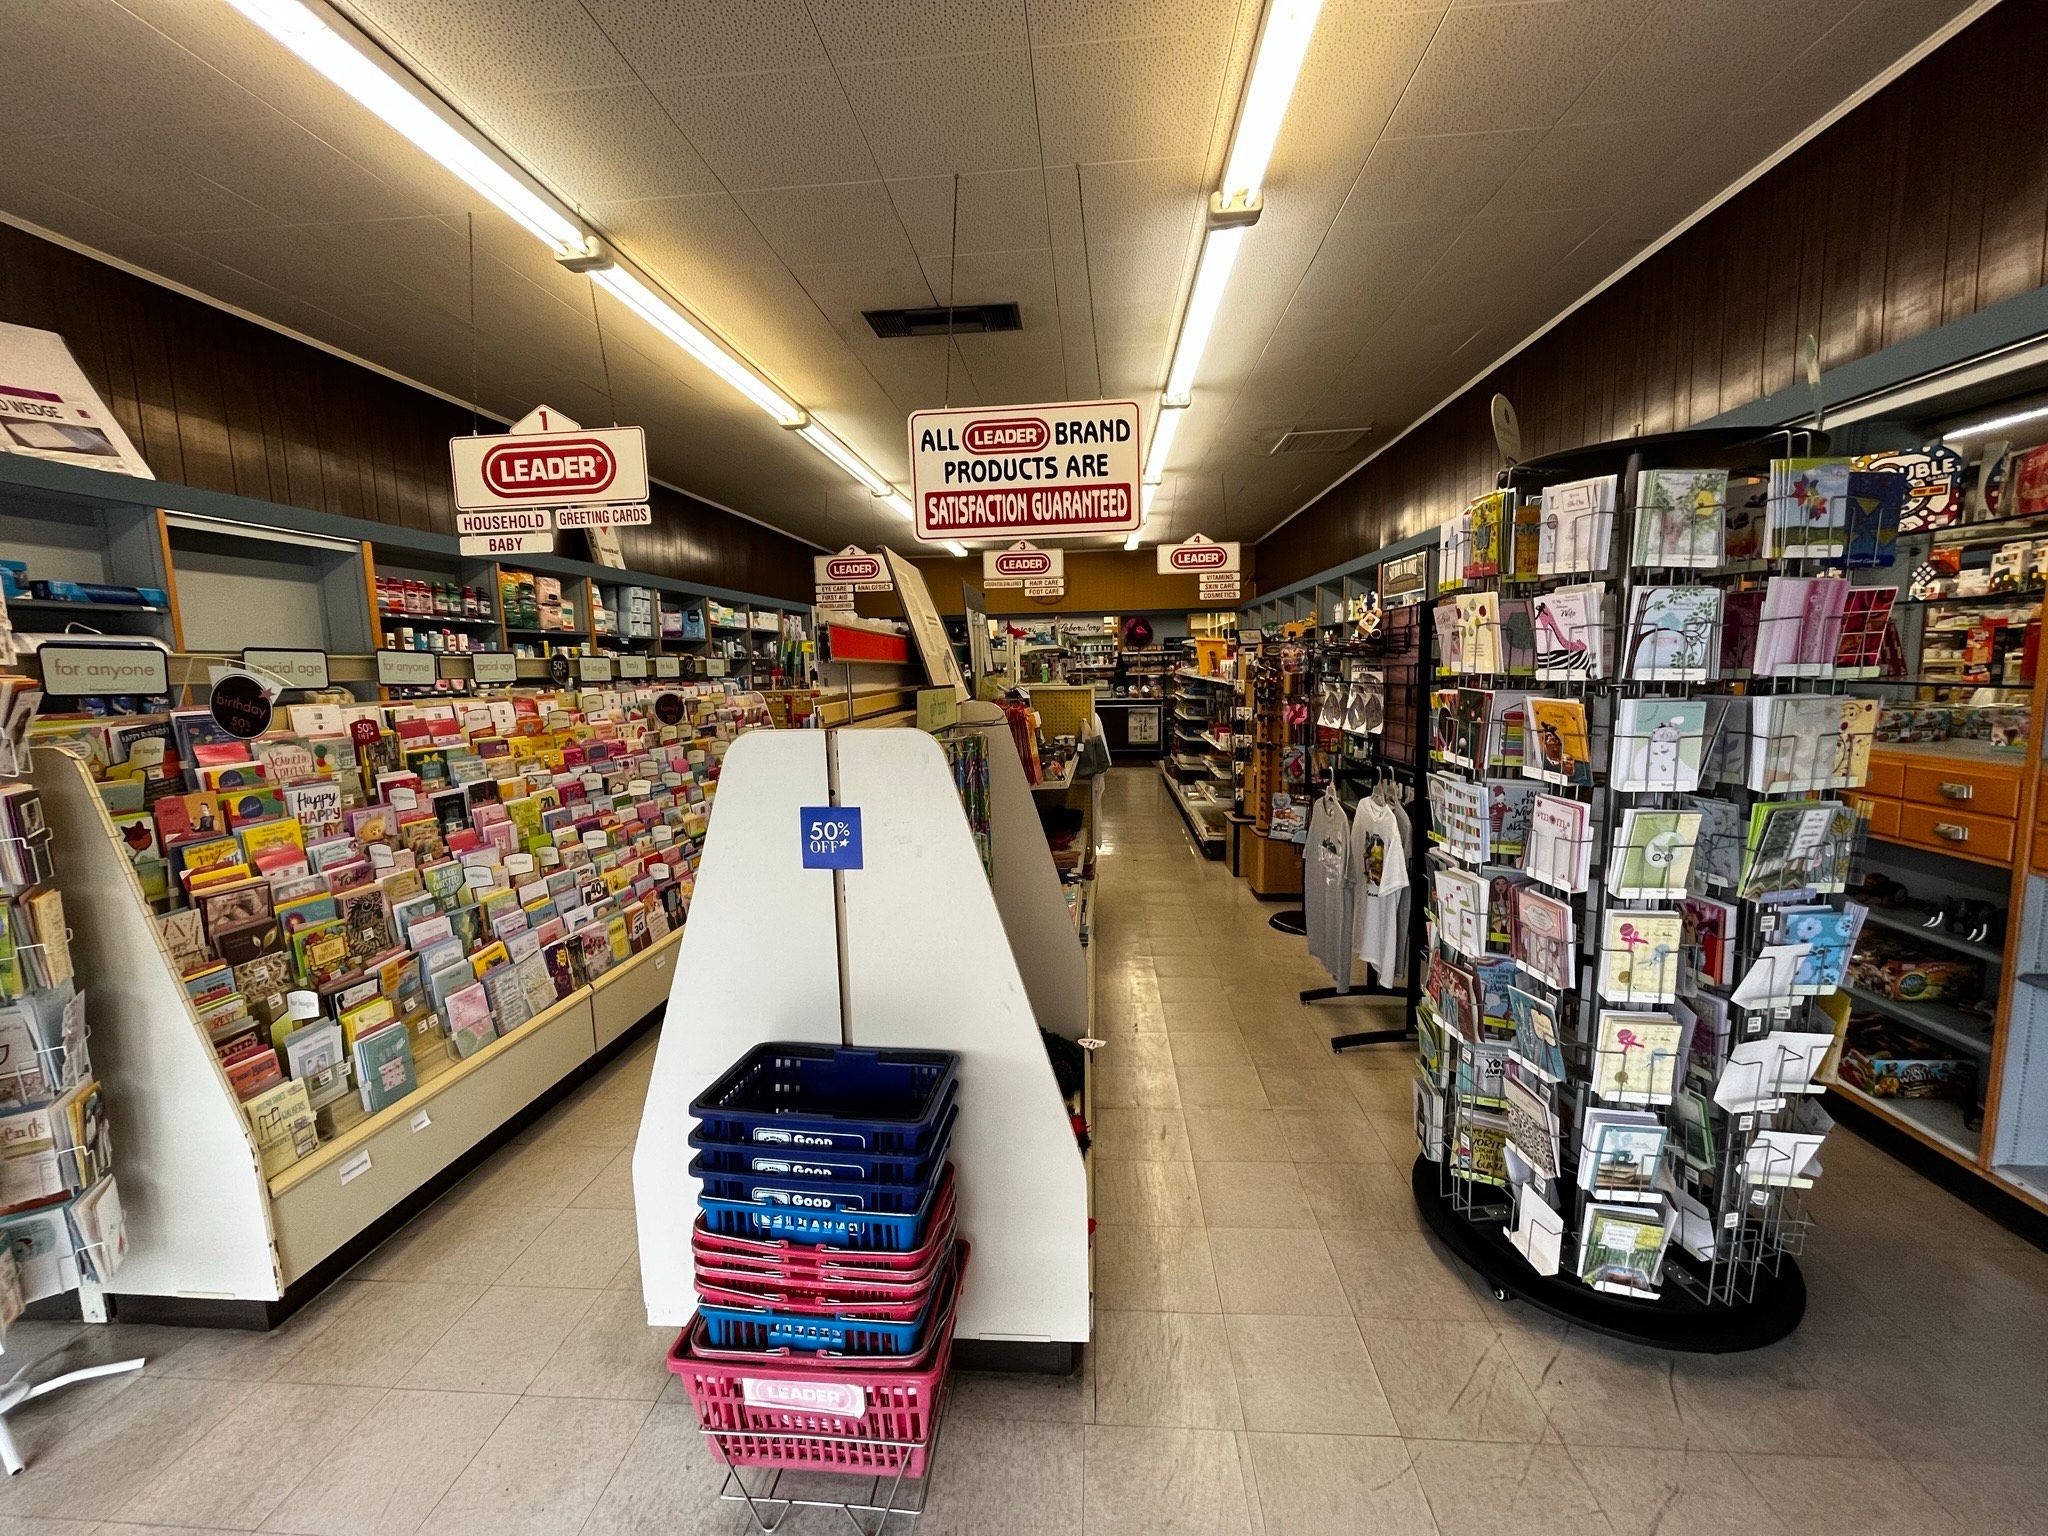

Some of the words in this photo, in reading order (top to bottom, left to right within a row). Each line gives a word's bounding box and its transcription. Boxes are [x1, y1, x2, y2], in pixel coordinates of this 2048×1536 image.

[11, 400, 65, 419] WEDGE
[538, 410, 549, 431] 1
[921, 427, 960, 452] ALL
[974, 428, 1037, 446] LEADER
[1055, 419, 1131, 445] BRAND
[500, 455, 597, 483] LEADER
[944, 456, 1058, 484] PRODUCTS
[1066, 453, 1109, 478] ARE
[928, 492, 1028, 525] SATISFACTION
[1031, 488, 1128, 521] GUARANTEED
[463, 514, 545, 531] HOUSEHOLD
[559, 510, 610, 526] GREETING
[612, 508, 648, 524] CARDS
[488, 537, 523, 552] BABY
[1020, 541, 1026, 550] 3
[1194, 535, 1200, 544] 4
[848, 546, 855, 555] 2
[1177, 552, 1219, 564] LEADER
[833, 564, 872, 575] LEADER
[1003, 559, 1043, 570] LEADER
[54, 658, 80, 676] for
[87, 665, 155, 681] anyone
[298, 664, 322, 677] age
[382, 658, 395, 672] for
[396, 663, 430, 674] anyone
[476, 660, 499, 674] special
[500, 663, 513, 674] age
[553, 660, 567, 670] 50%
[216, 691, 266, 719] birthday
[357, 723, 373, 733] 50%
[296, 790, 338, 812] Happy
[540, 795, 555, 808] 70
[297, 807, 342, 826] HAPPY
[322, 822, 342, 838] AY
[810, 821, 850, 840] 50%
[810, 840, 839, 853] OFF
[590, 883, 602, 895] 40
[634, 921, 644, 934] 30
[767, 1385, 841, 1404] LEADER
